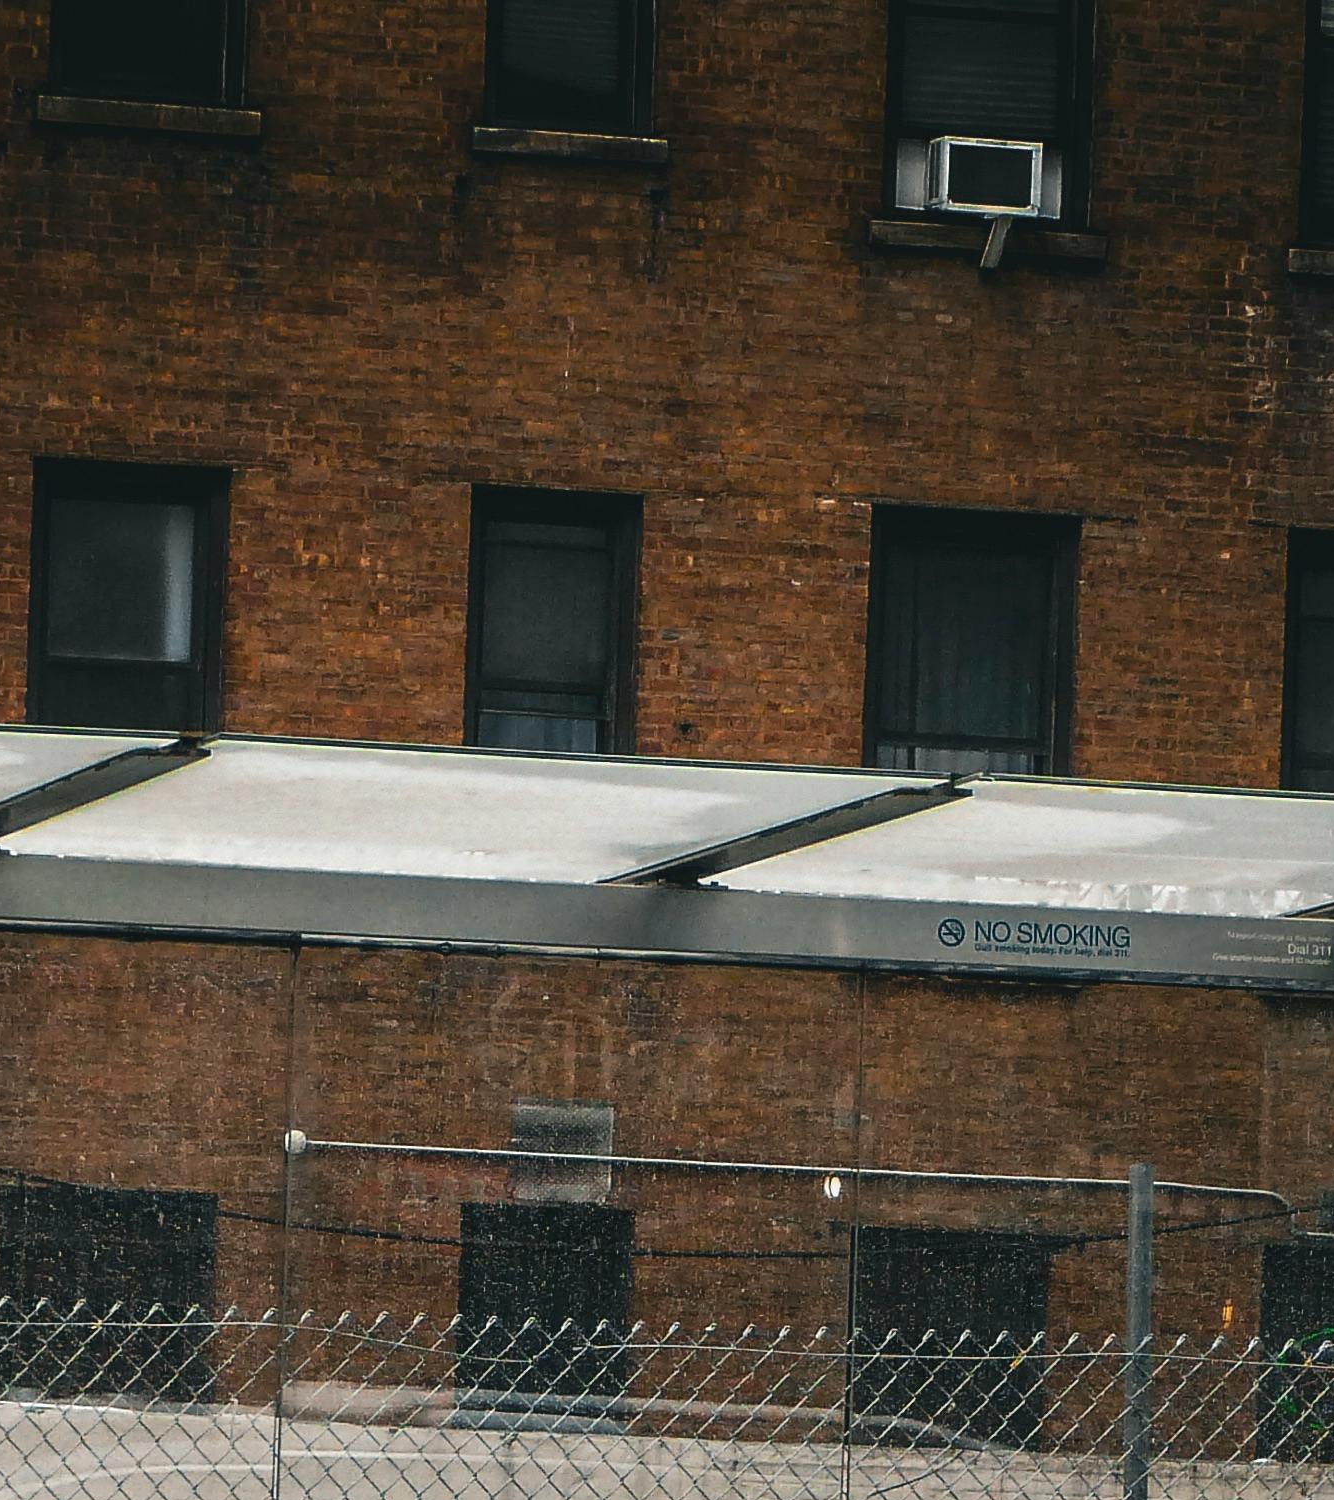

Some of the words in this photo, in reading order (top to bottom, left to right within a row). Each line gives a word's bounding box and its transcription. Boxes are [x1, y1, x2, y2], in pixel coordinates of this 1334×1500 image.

[974, 920, 1011, 943] NO
[1017, 921, 1131, 948] SMOKING
[995, 944, 1030, 954] smoking
[1287, 943, 1309, 956] Dial
[1312, 944, 1332, 957] 311
